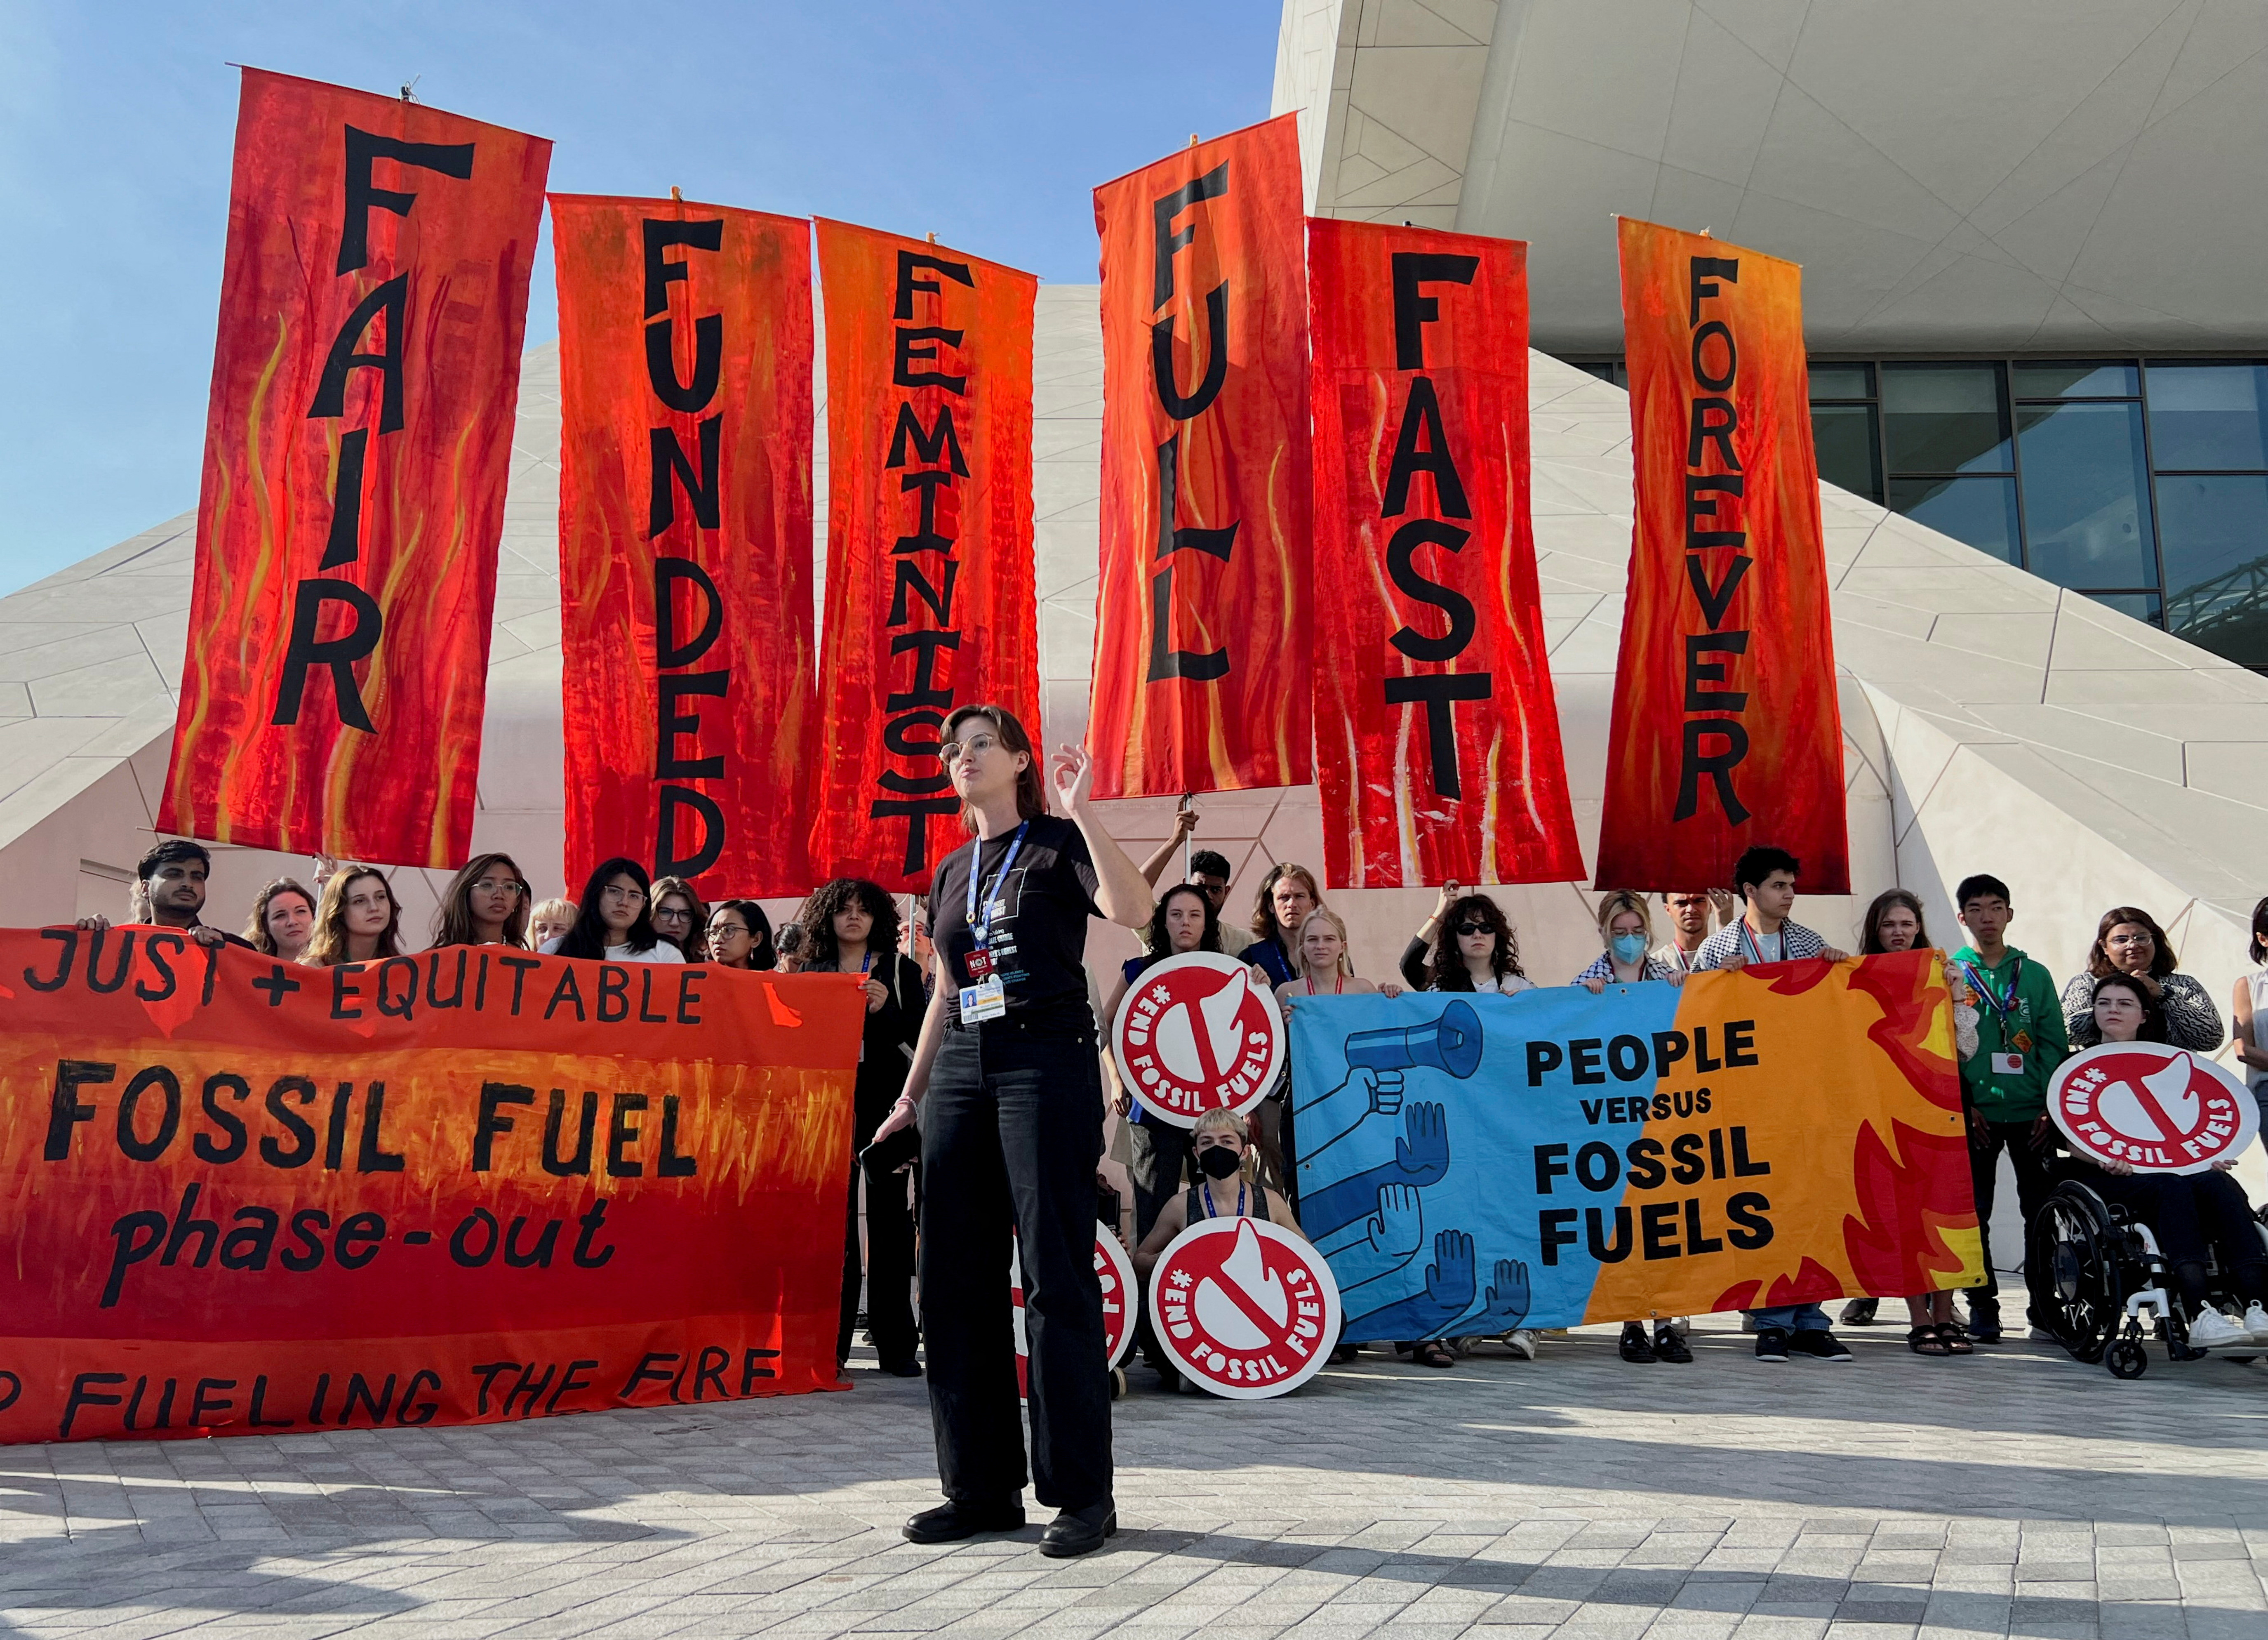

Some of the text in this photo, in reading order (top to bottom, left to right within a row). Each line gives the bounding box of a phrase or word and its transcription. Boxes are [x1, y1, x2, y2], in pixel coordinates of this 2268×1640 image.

[271, 123, 475, 734] FAIR
[1147, 160, 1240, 682] FULL
[643, 219, 729, 879] FUNDED
[870, 250, 974, 876] FEMINIST
[1381, 252, 1492, 801] FAST
[1673, 257, 1752, 826] FOREVER
[24, 930, 226, 1006] JUST
[330, 950, 707, 1024] EQUITABLE
[1128, 985, 1268, 1111] #END FOSSIL FUELS
[1526, 1020, 1758, 1086] PEOPLE
[1580, 1088, 1712, 1125] VERSUS
[44, 1059, 696, 1177] FOSSIL FUEL
[1534, 1126, 1771, 1194] FOSSIL
[2066, 1067, 2233, 1164] #END FOSSIL FUELS
[99, 1183, 615, 1308] phase-out
[1539, 1192, 1774, 1265] FUELS
[1165, 1268, 1319, 1381] #END FOSSIL FUELS
[59, 1369, 441, 1437] FUELING
